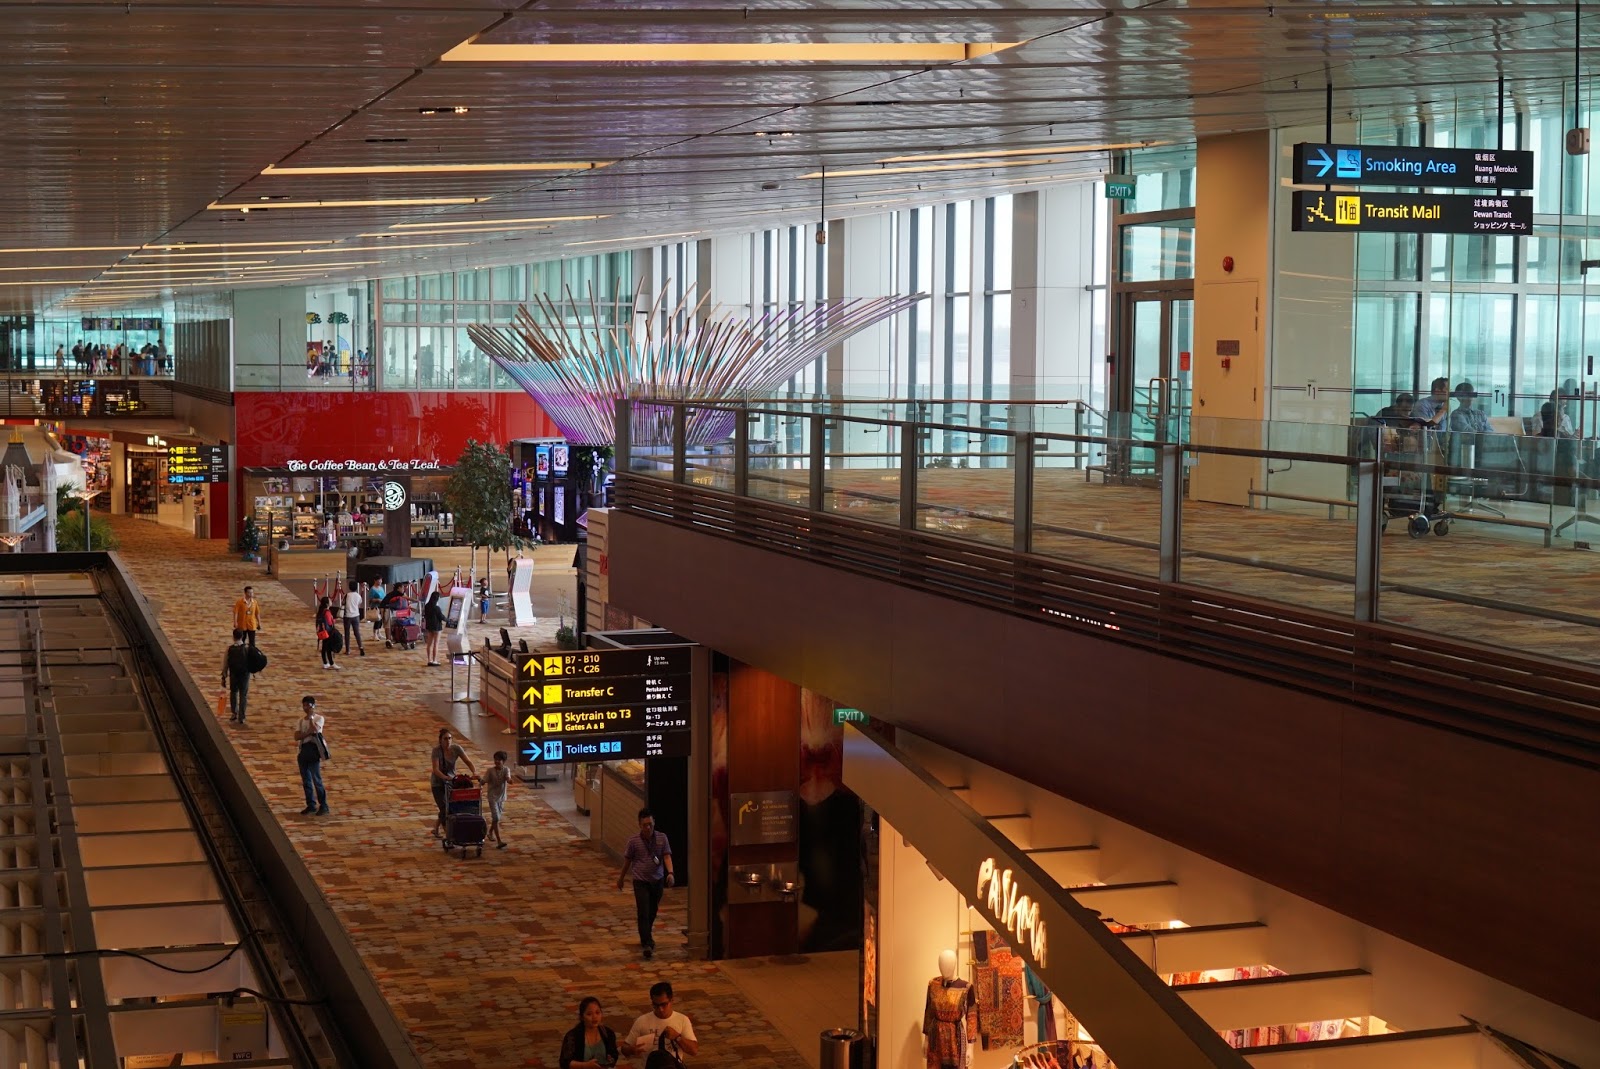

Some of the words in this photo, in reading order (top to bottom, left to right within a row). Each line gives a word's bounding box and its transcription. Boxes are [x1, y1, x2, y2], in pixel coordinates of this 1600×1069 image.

[1366, 158, 1422, 175] Smoking
[1426, 160, 1456, 173] Area
[1475, 165, 1492, 173] Ruang
[1494, 165, 1518, 173] Merokok
[1475, 176, 1496, 184] 喫煙所
[1109, 186, 1127, 197] EXIT
[1474, 199, 1509, 208] 过境购物区
[1365, 204, 1409, 218] Transit
[1412, 206, 1440, 219] Mall
[1493, 211, 1512, 219] Transit
[1473, 222, 1508, 230] ショッピング
[287, 460, 307, 472] The
[309, 460, 344, 471] Coffee
[377, 460, 388, 470] &
[387, 460, 409, 470] Tea
[565, 656, 576, 664] B7
[583, 654, 600, 663] B10
[565, 666, 575, 674] C1
[583, 665, 600, 673] C26
[565, 687, 604, 698] Transfer
[606, 686, 614, 696] C
[564, 711, 604, 723] Skytrain
[606, 711, 617, 719] to
[618, 709, 631, 719] T3
[838, 711, 859, 723] EXIT
[565, 724, 585, 732] Gates
[565, 744, 597, 754] Toilets
